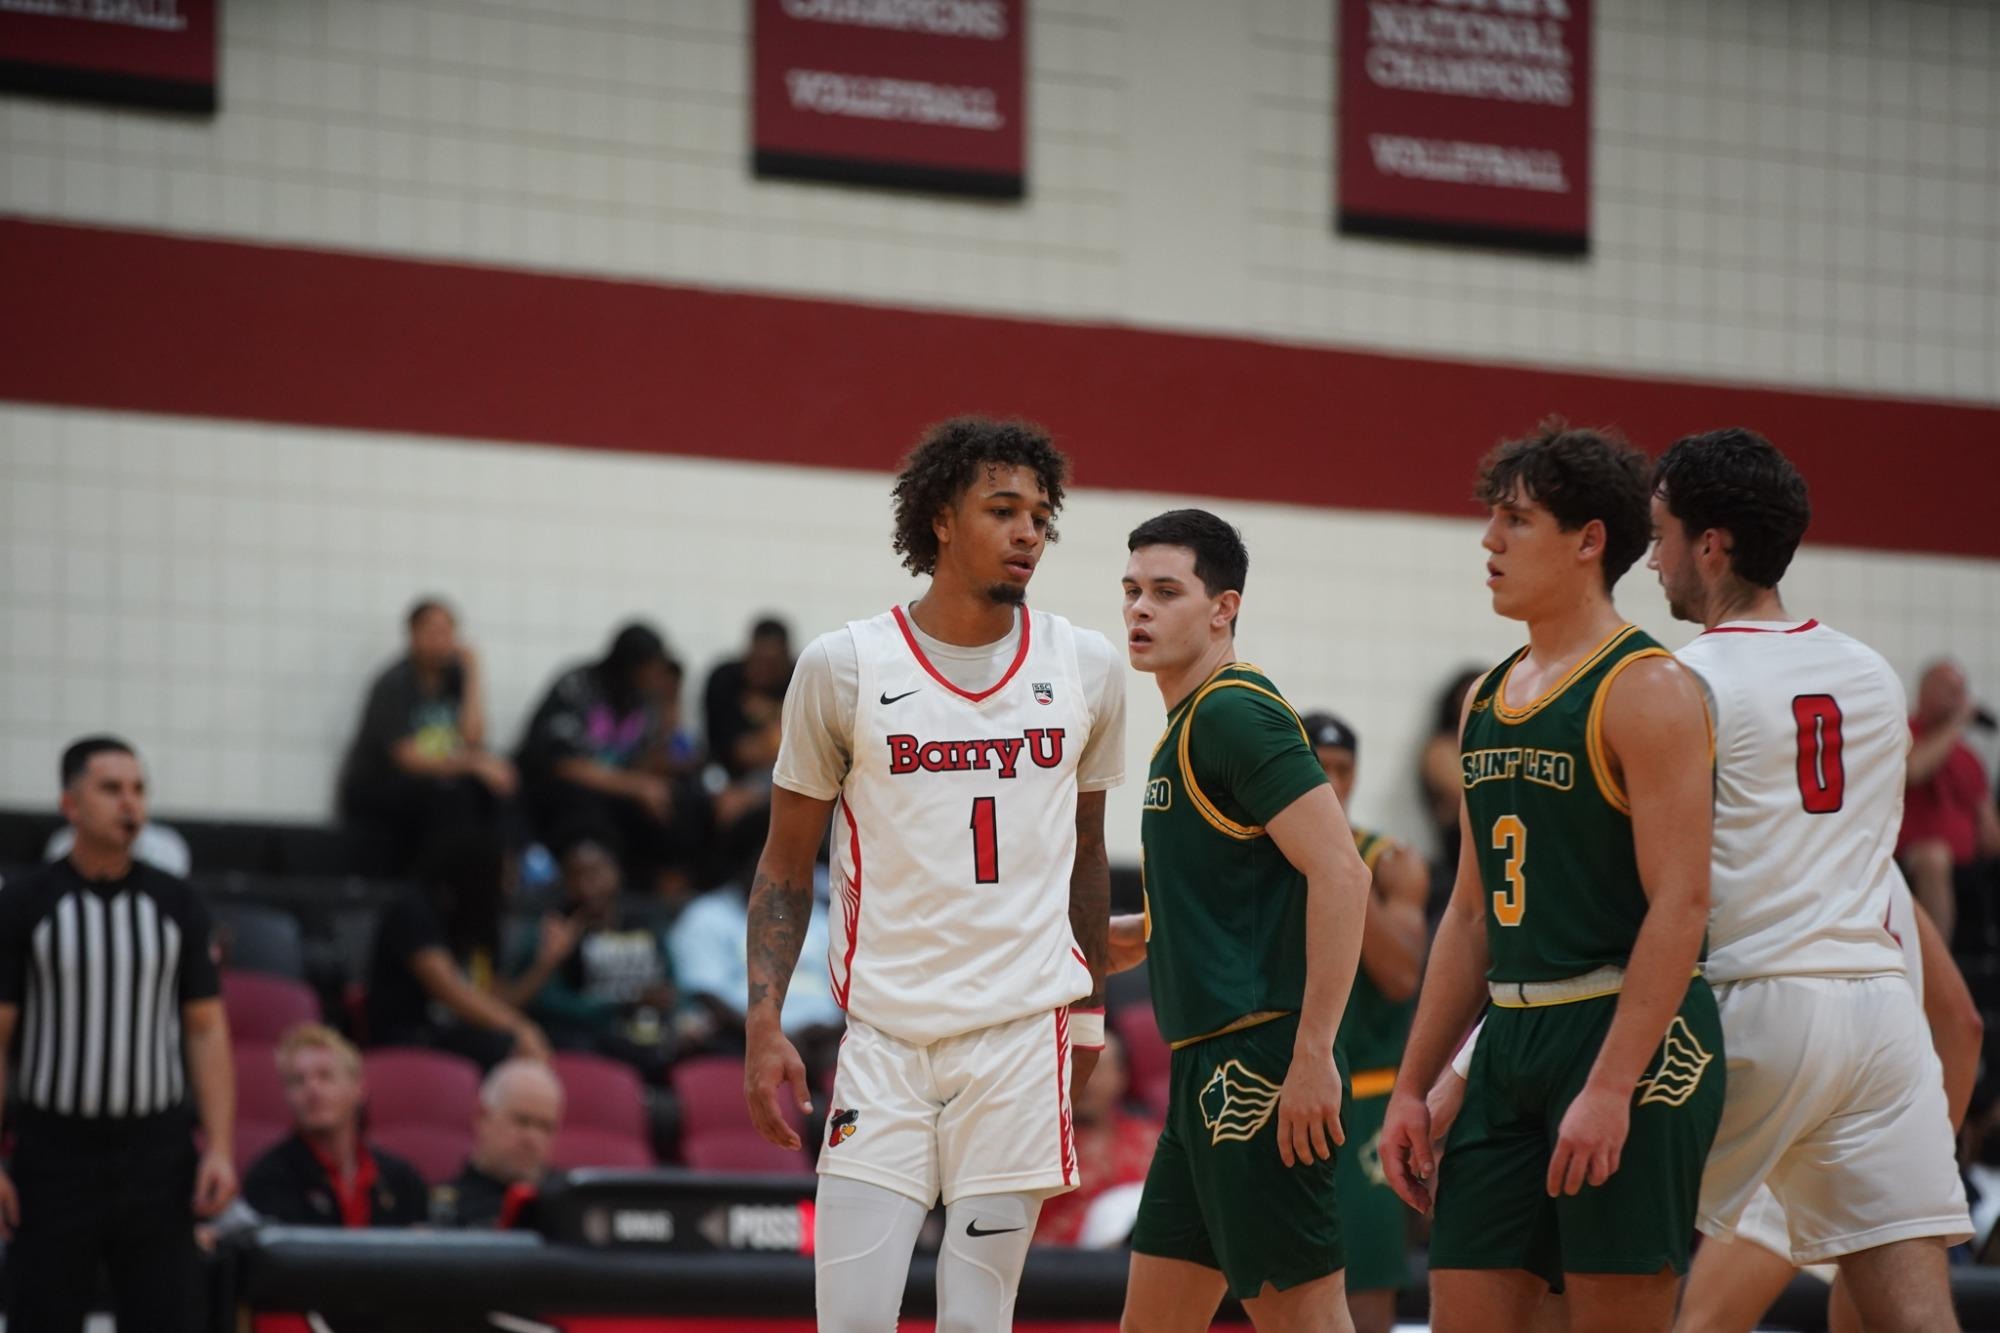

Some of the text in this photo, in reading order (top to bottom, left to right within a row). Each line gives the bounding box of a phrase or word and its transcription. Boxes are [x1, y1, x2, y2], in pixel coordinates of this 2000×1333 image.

[785, 68, 1005, 131] VOLLEYBALL
[1369, 133, 1571, 193] VOLLEYBALL
[1461, 747, 1574, 791] SAINT LEO
[1792, 693, 1845, 814] 0
[969, 796, 999, 884] 1
[1492, 815, 1527, 926] 3
